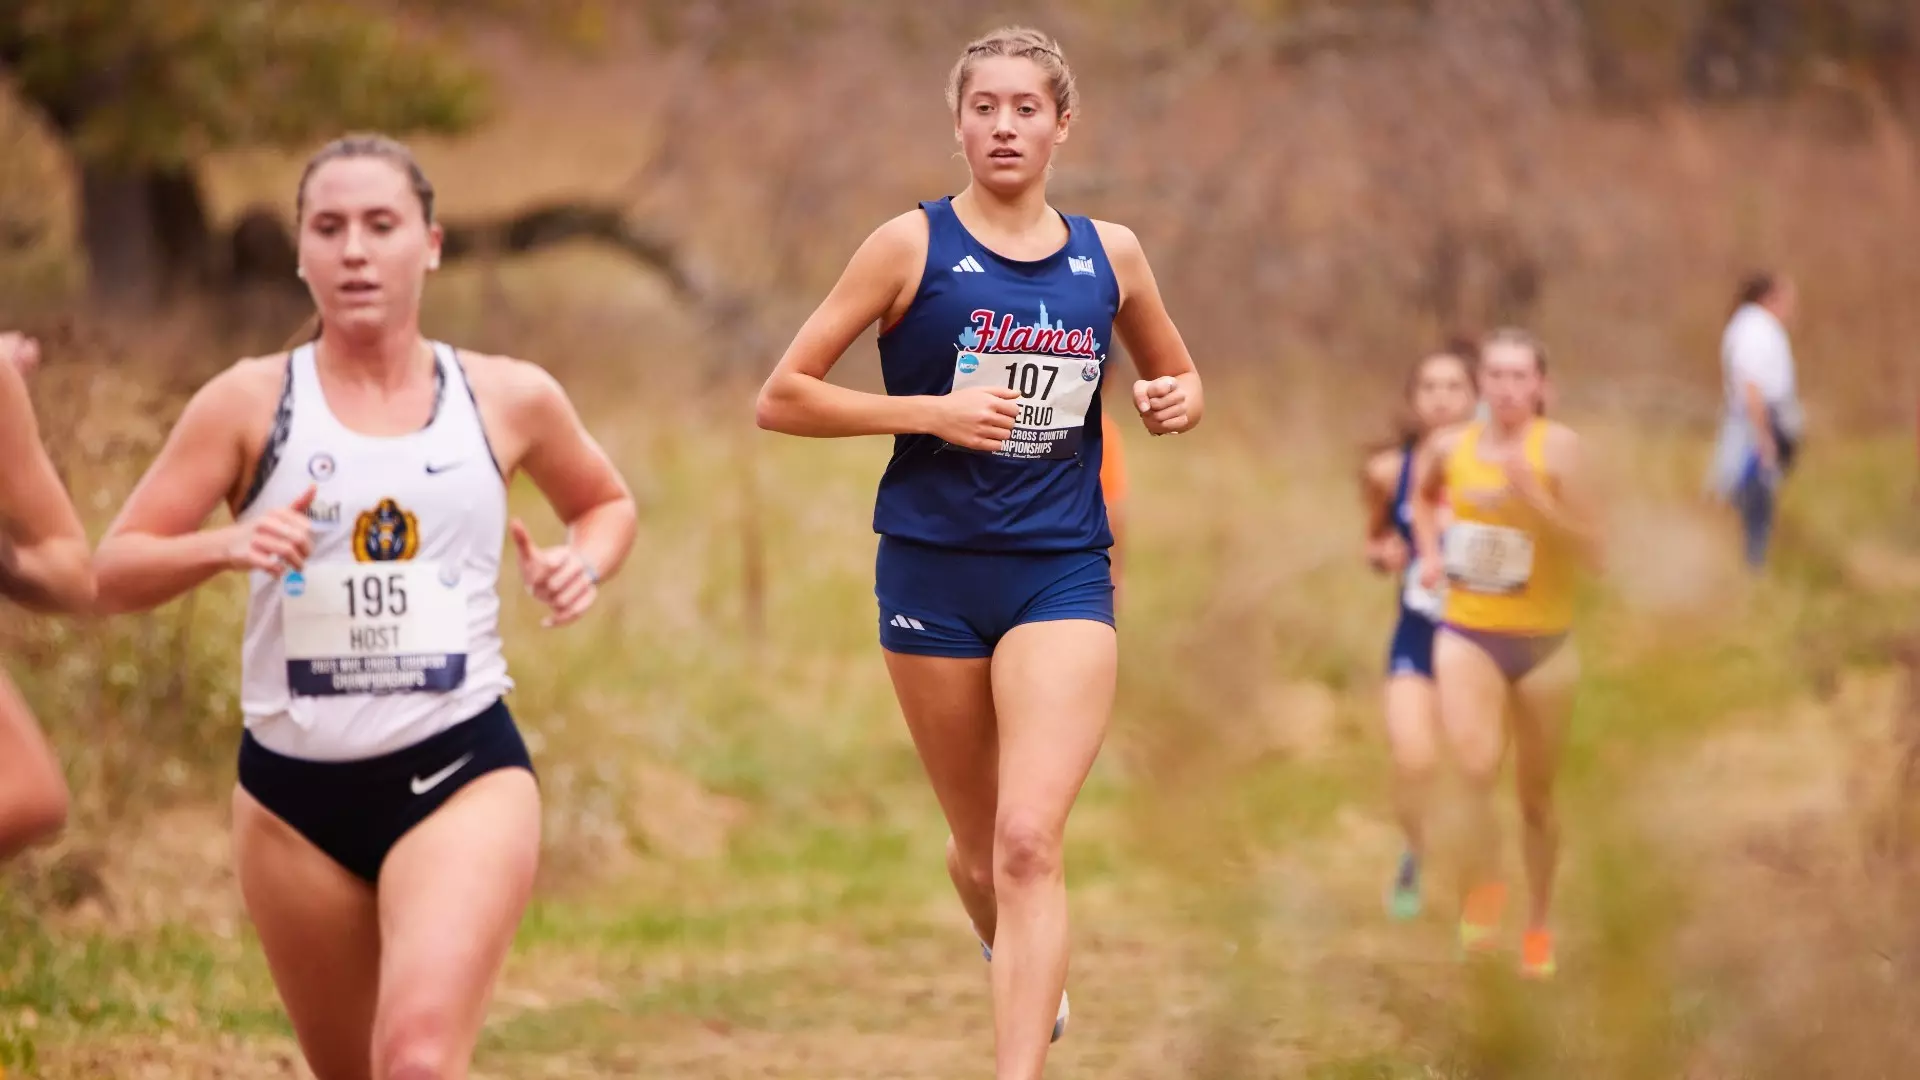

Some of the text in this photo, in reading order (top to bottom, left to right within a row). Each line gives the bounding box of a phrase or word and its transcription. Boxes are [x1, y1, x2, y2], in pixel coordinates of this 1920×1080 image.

[964, 309, 1096, 360] Flames
[1005, 362, 1059, 401] 107
[1014, 403, 1054, 426] ERUD
[1000, 439, 1053, 454] MPIONSHIPS
[1011, 429, 1069, 441] CROSS COUNTRY
[342, 574, 408, 618] 195
[350, 625, 401, 650] HOST
